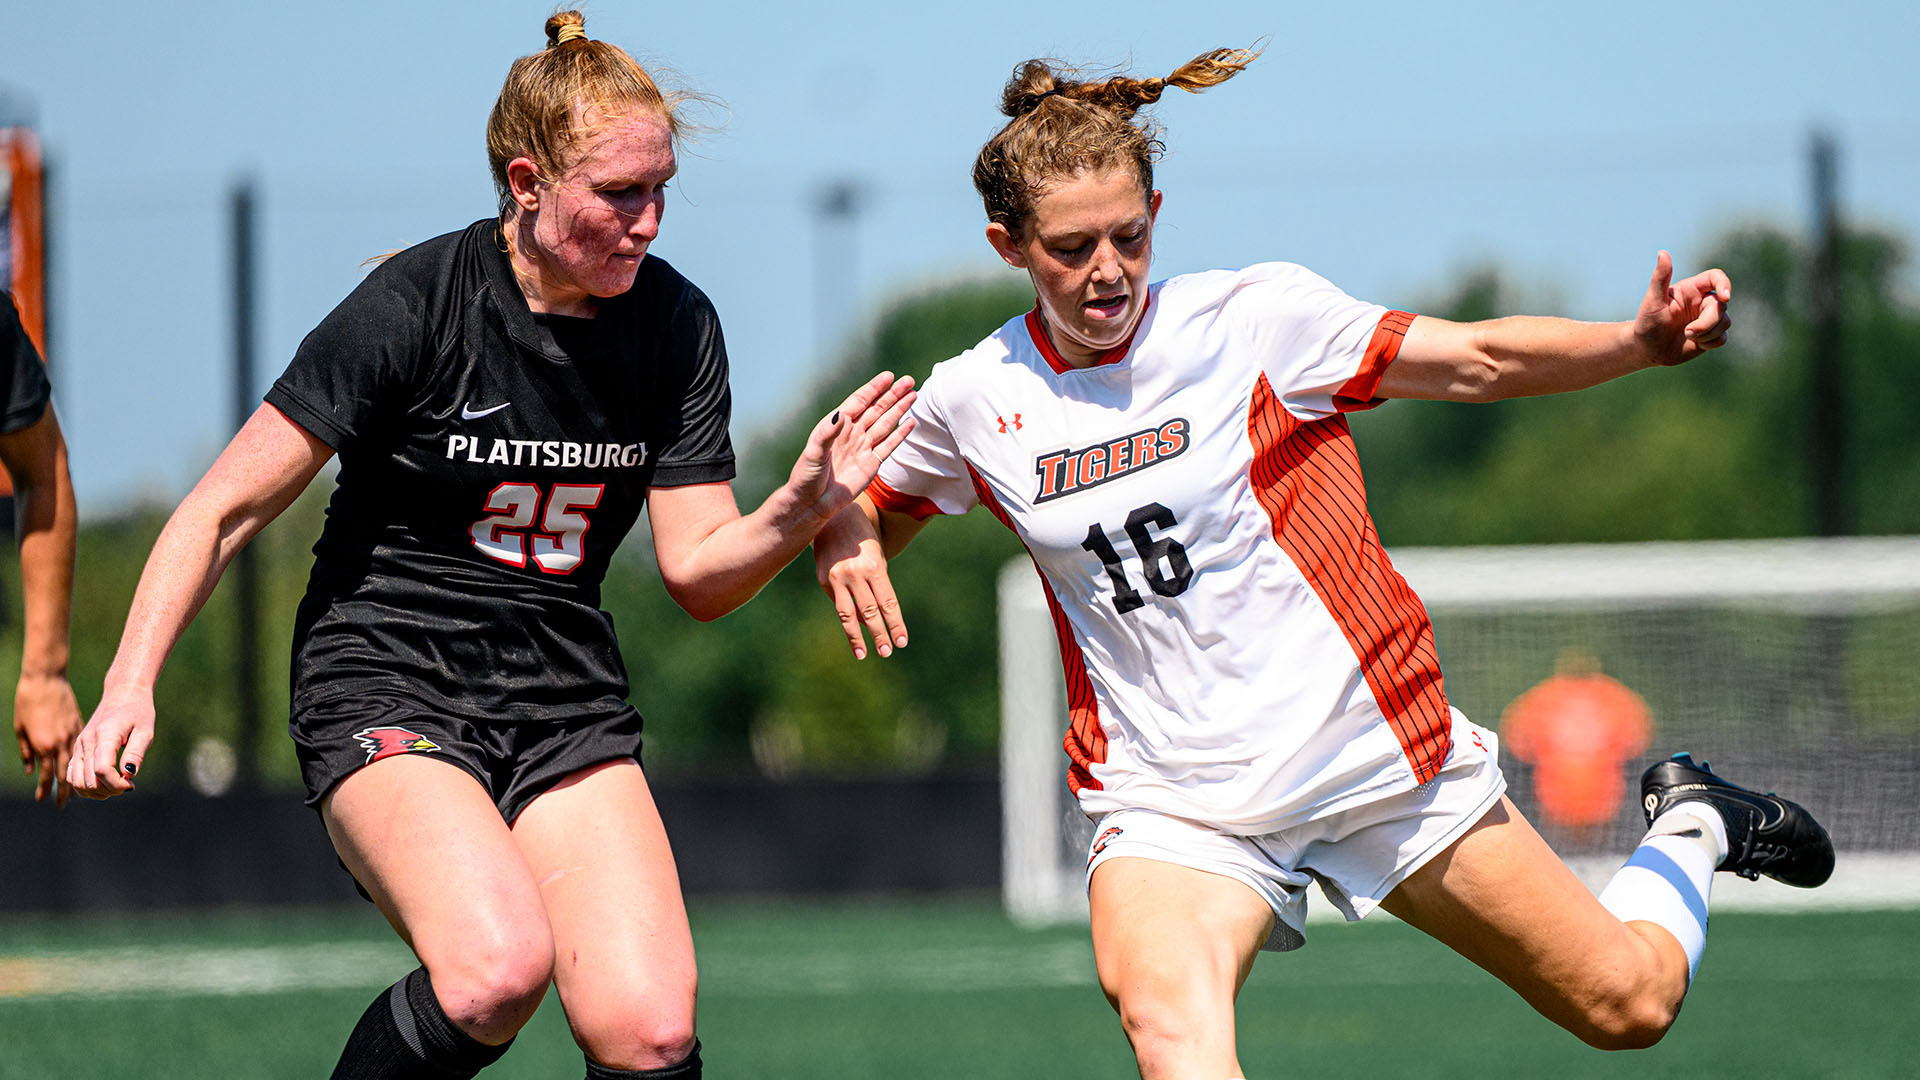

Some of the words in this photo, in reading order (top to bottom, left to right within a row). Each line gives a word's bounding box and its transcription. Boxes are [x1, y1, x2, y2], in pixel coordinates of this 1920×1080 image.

[1033, 417, 1190, 505] TIGERS
[468, 481, 605, 575] 25
[1081, 502, 1194, 615] 16
